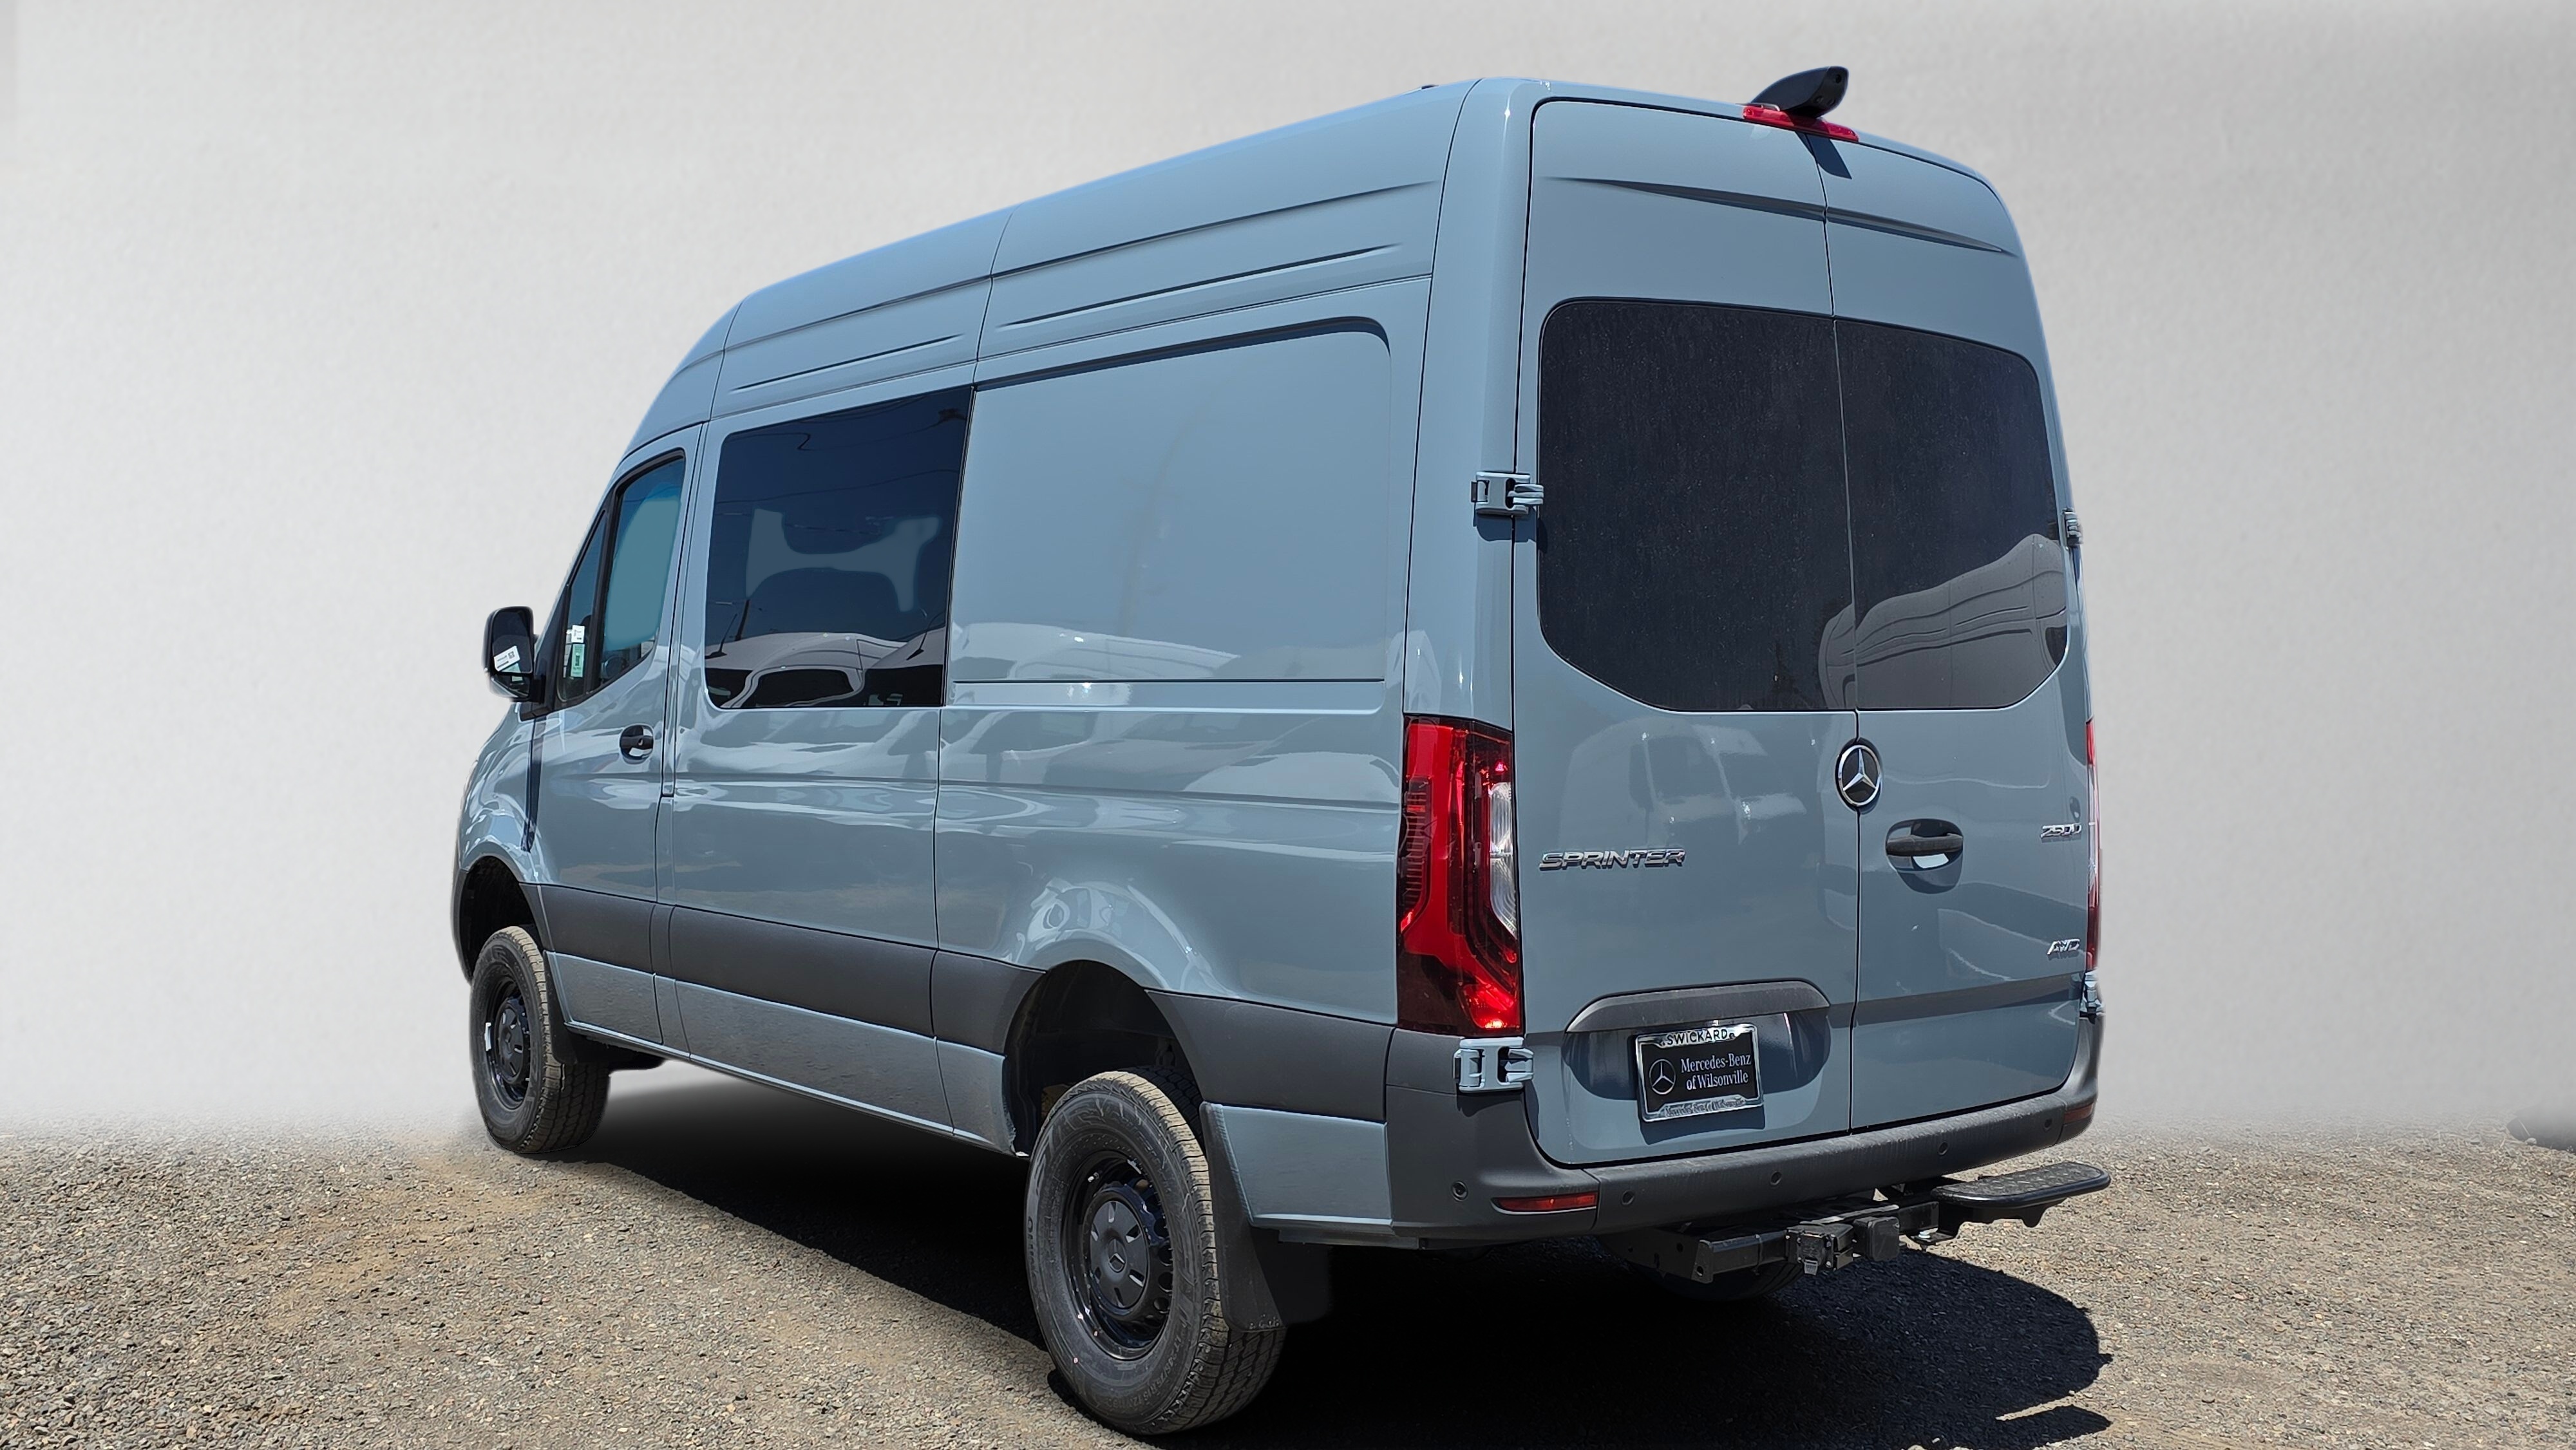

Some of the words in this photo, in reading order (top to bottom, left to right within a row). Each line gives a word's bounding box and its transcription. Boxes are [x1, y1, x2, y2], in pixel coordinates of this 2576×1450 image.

[2040, 823, 2082, 838] 2500
[1539, 849, 1685, 871] SPRINTER
[1667, 1029, 1728, 1045] SWICKARD
[1681, 1053, 1751, 1073] Mercedes-Benz
[1686, 1074, 1697, 1091] of
[1697, 1069, 1749, 1089] Wilsonville
